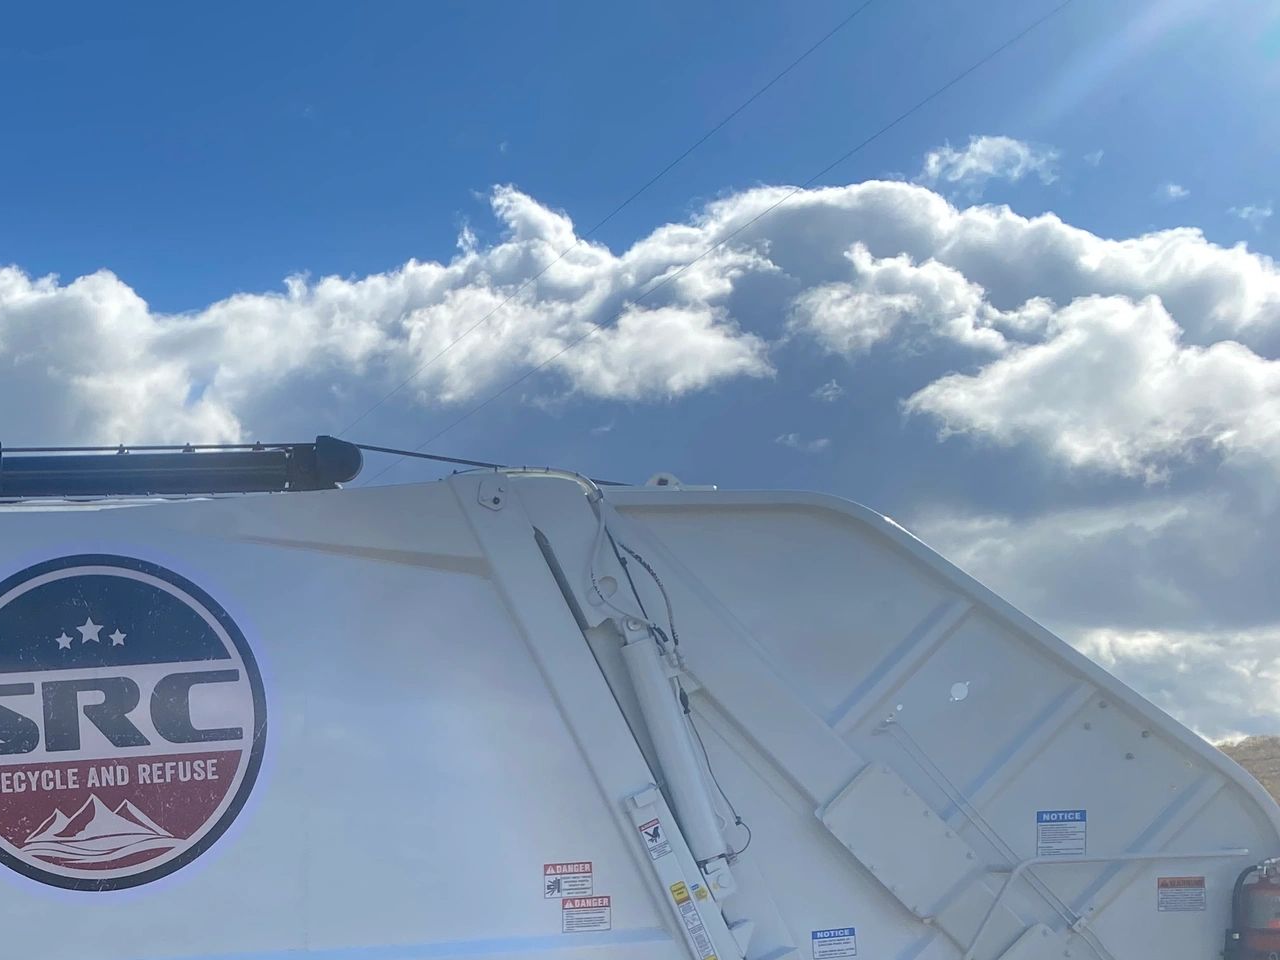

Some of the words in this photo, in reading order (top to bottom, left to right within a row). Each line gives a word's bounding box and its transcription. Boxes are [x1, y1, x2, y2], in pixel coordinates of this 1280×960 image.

[87, 764, 130, 787] AND
[138, 759, 219, 784] REFUSE
[1042, 812, 1081, 821] NOTICE
[556, 863, 591, 874] DANGER
[574, 897, 609, 908] DANGER
[817, 930, 850, 938] NOTICE
